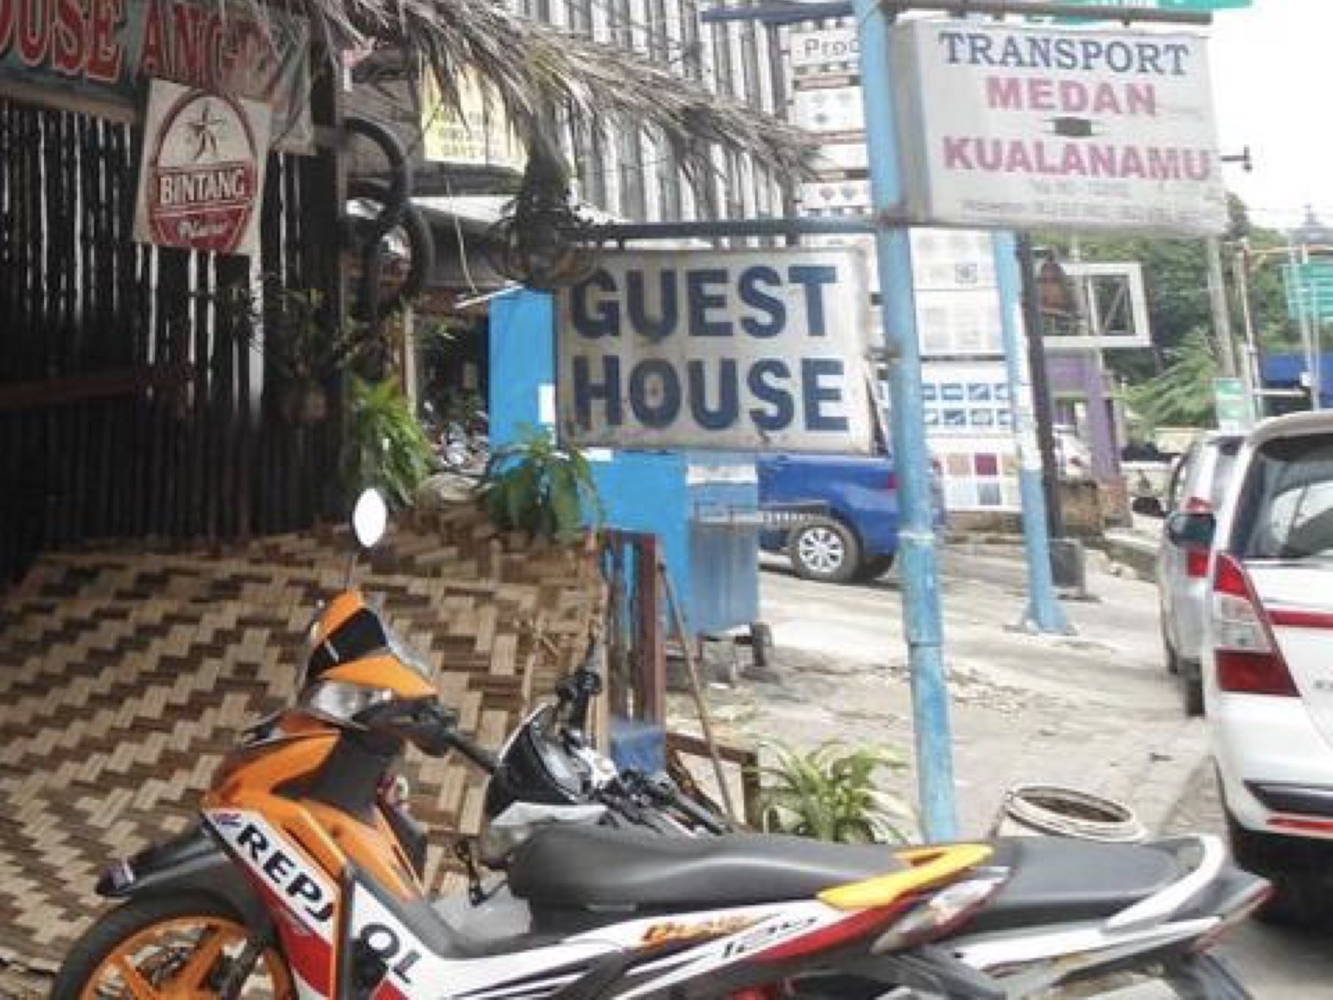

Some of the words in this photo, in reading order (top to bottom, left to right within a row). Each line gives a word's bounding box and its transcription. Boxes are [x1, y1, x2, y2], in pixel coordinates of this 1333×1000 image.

[938, 31, 1190, 76] TRANSPORT
[985, 75, 1157, 116] MEDAN
[943, 136, 1212, 180] KUALANAMU
[159, 168, 246, 205] BINTANG
[571, 264, 837, 339] GUEST
[573, 355, 849, 431] HOUSE
